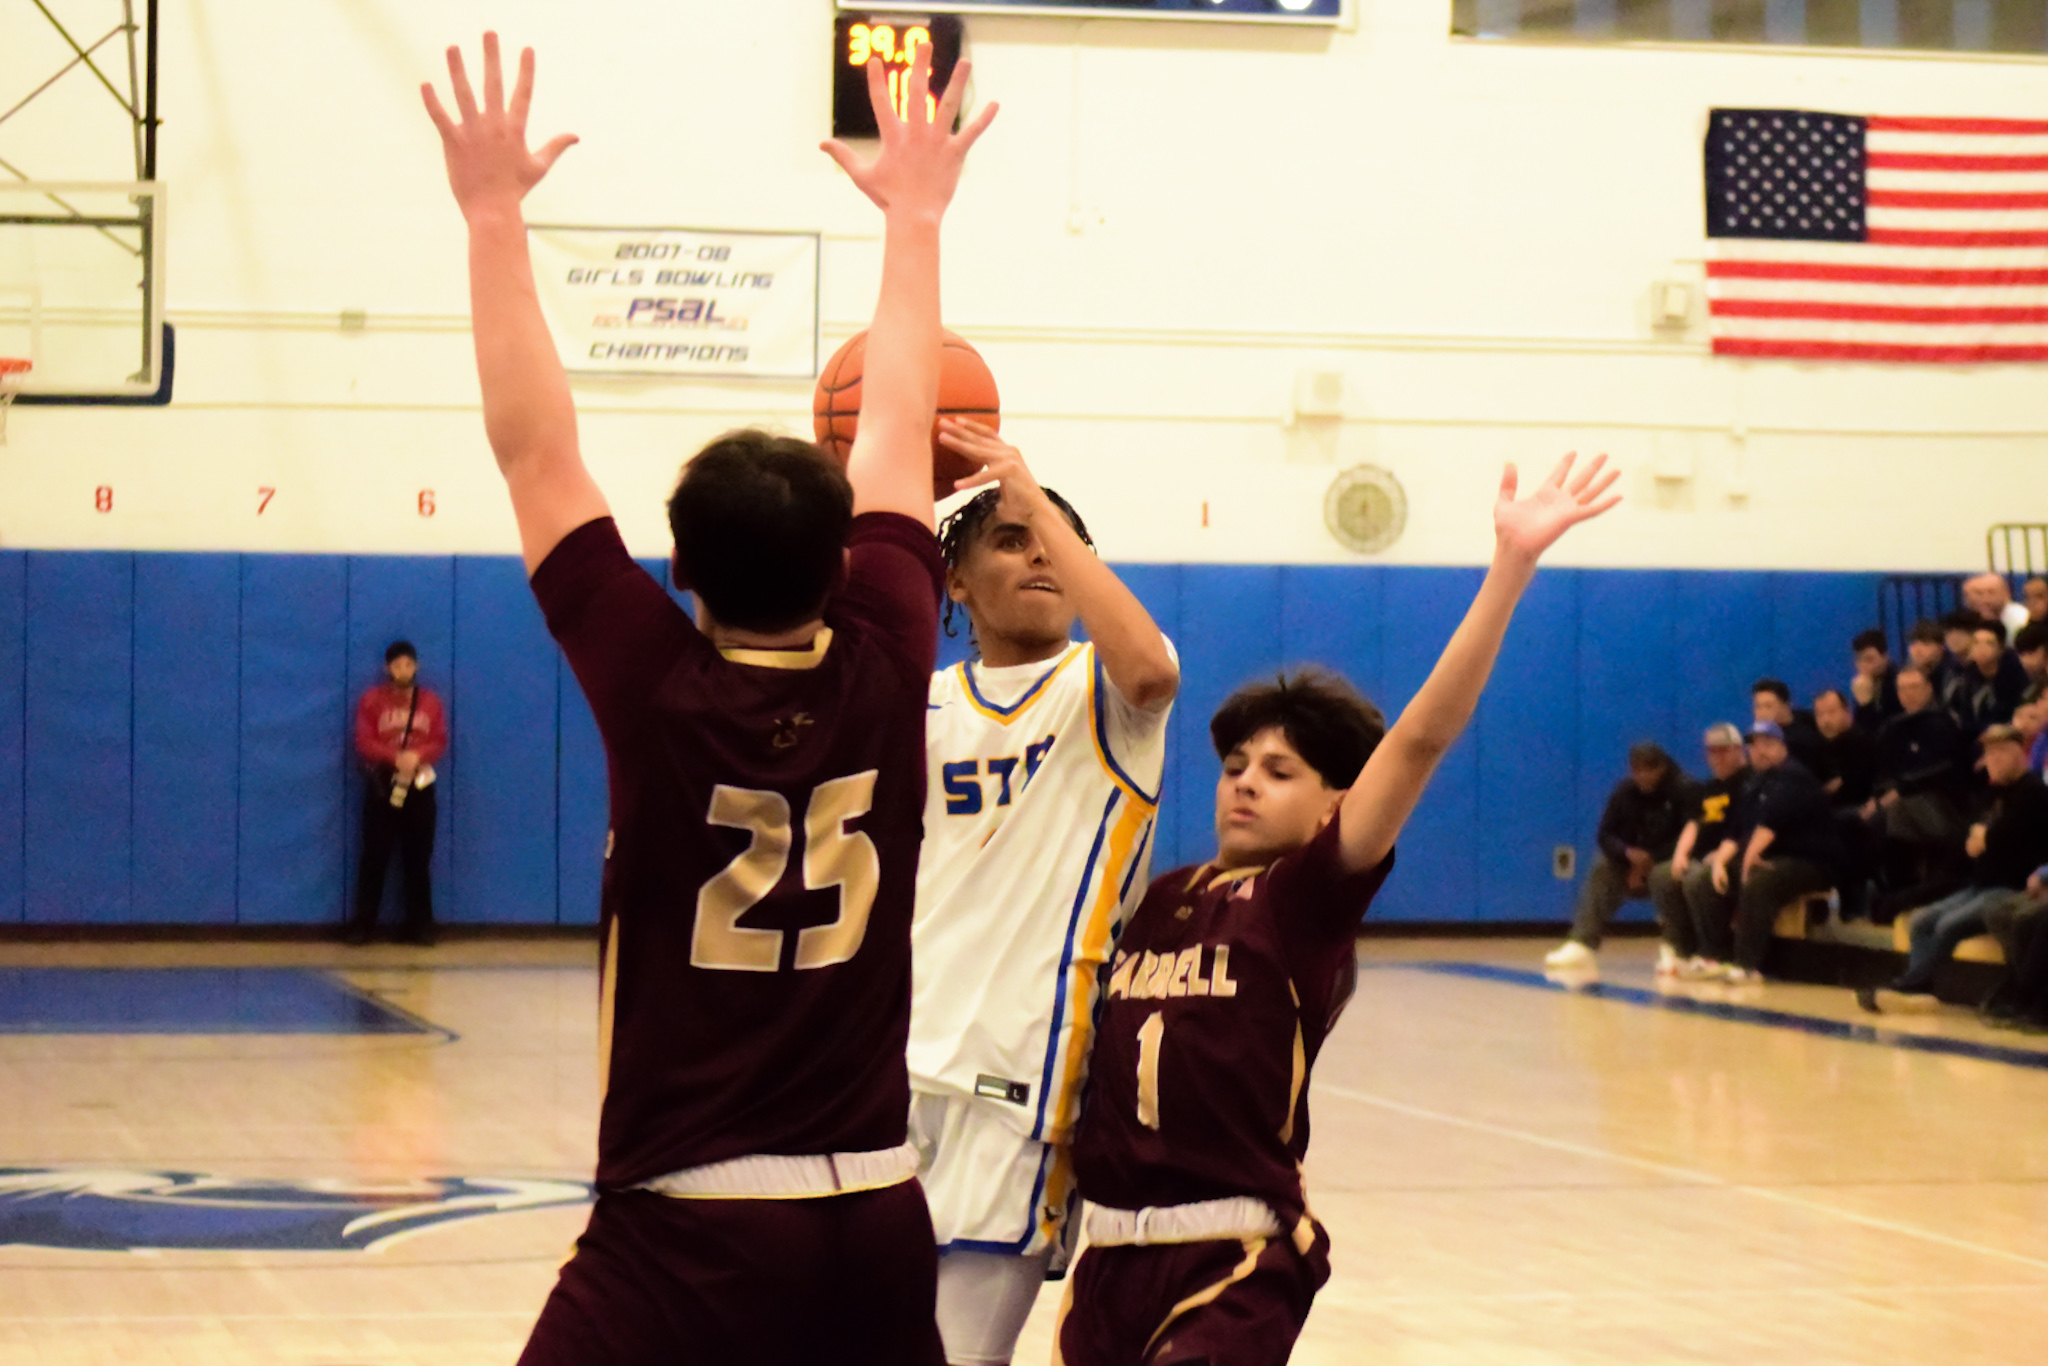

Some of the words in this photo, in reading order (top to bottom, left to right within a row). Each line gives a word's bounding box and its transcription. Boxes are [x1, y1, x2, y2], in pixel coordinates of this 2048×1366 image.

[615, 243, 732, 262] 2007-08
[567, 268, 644, 286] GIRLS
[655, 269, 775, 289] BOWLING
[589, 342, 750, 363] CHAMPIONS
[95, 486, 113, 514] 8
[256, 487, 276, 515] 7
[418, 490, 436, 517] 6
[690, 769, 881, 971] 25
[1136, 1010, 1165, 1131] 1
